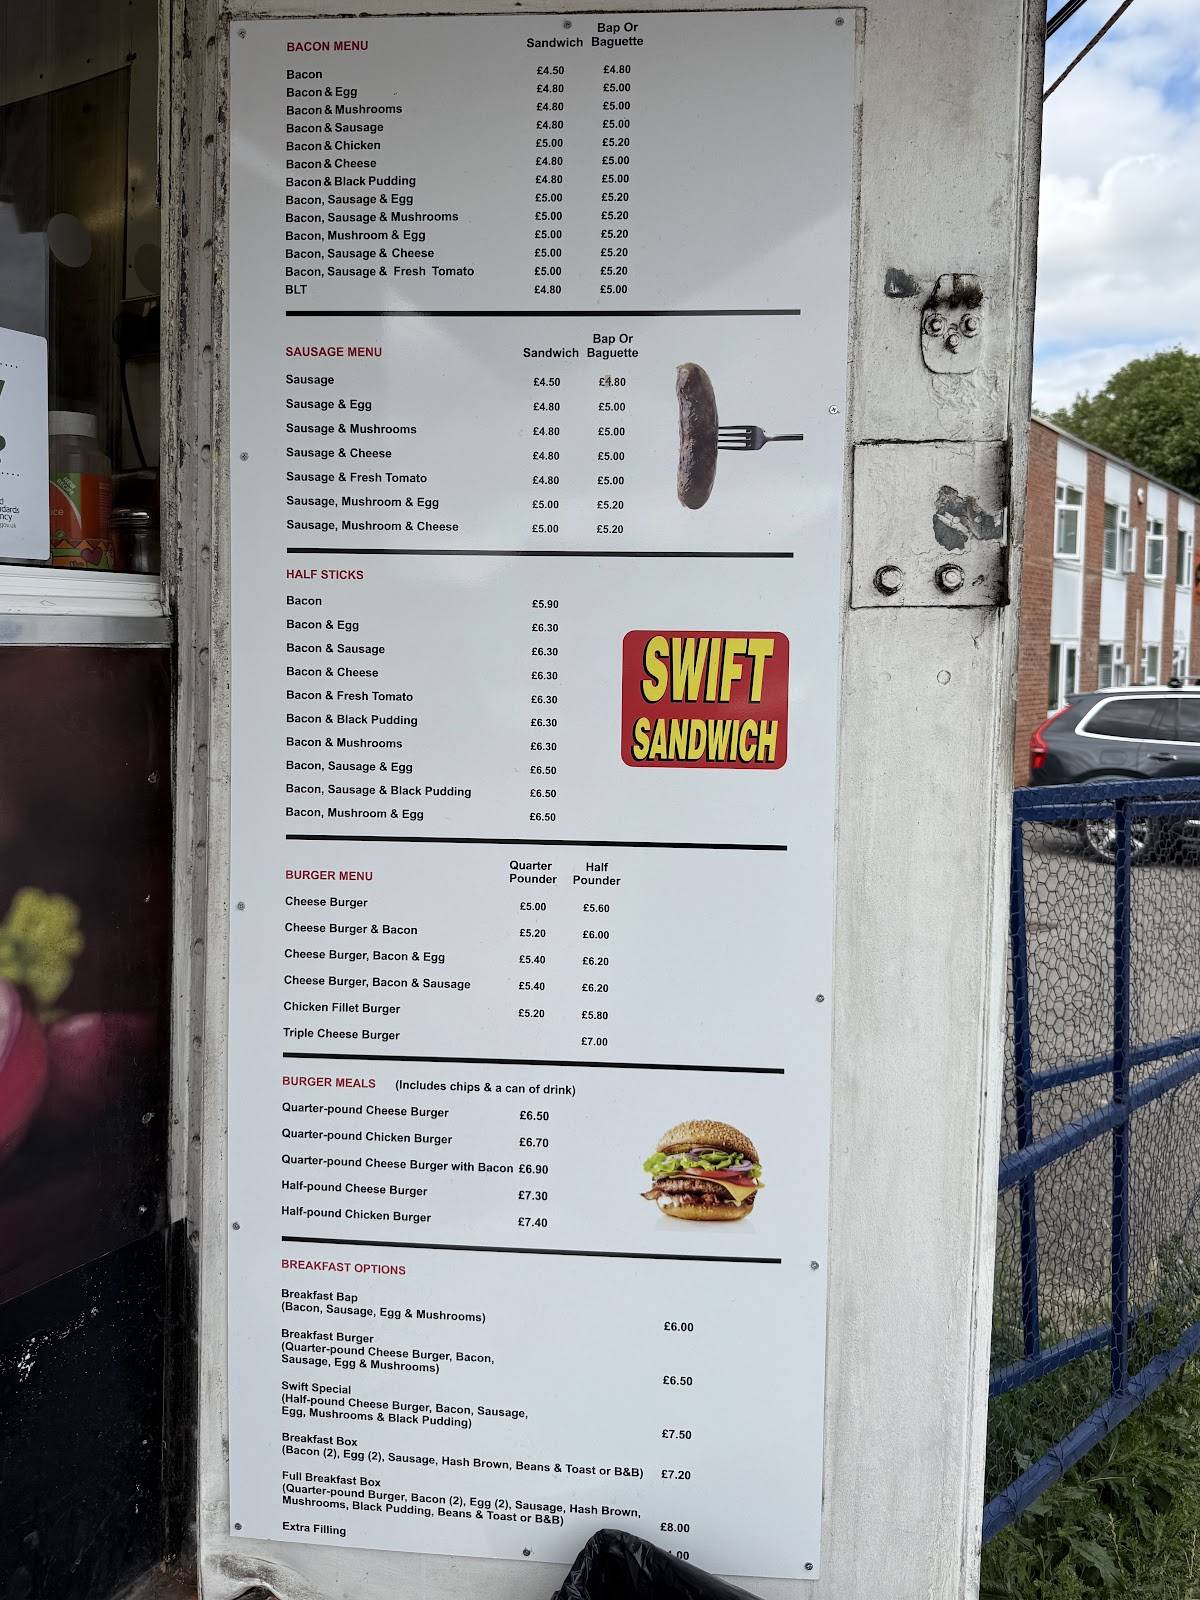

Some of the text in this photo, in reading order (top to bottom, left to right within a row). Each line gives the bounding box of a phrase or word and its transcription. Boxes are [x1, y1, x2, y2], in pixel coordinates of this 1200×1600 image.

[597, 22, 639, 35] Bap Or
[286, 40, 368, 52] BACON MENU
[526, 36, 584, 48] Sandwich
[591, 36, 644, 49] Baguette
[286, 69, 323, 80] Bacon
[536, 65, 565, 75] £4.50
[603, 64, 631, 74] £4.80
[286, 104, 402, 116] Bacon & Mushrooms
[536, 102, 564, 112] £4.80
[602, 101, 631, 111] £5.00
[286, 175, 416, 188] Bacon & Black Pudding
[535, 174, 563, 184] £4.80
[601, 174, 630, 184] £5.00
[285, 248, 435, 261] Bacon, Sausage & Cheese
[534, 248, 562, 258] £5.00
[600, 247, 628, 257] £5.20
[285, 284, 308, 295] BLT
[534, 284, 562, 294] £4.80
[600, 284, 628, 294] £5.00
[593, 333, 634, 346] Bap Or
[285, 346, 382, 357] SAUSAGE MENU
[523, 347, 579, 358] Sandwich
[587, 347, 639, 360] Baguette
[286, 398, 372, 412] Sausage & Egg
[533, 402, 560, 412] £4.80
[598, 402, 626, 412] £5.00
[286, 495, 439, 510] Sausage, Mushroom & Egg
[532, 500, 559, 509] £5.00
[596, 500, 624, 510] £5.20
[286, 569, 364, 580] HALF STICKS
[286, 619, 359, 632] Bacon & Egg
[531, 623, 559, 632] £6.30
[640, 635, 775, 703] SWIFT
[631, 716, 779, 764] SANDWICH
[286, 760, 413, 774] Bacon, Sausage & Egg
[530, 765, 557, 775] £6.50
[286, 807, 424, 822] Bacon, Mushroom & Egg
[529, 812, 556, 822] £6.50
[509, 860, 553, 871] Quarter
[586, 862, 609, 872] Half
[286, 870, 373, 881] BURGER MENU
[509, 873, 558, 884] Pounder
[573, 875, 621, 886] Pounder
[284, 974, 471, 992] Cheese Burger, Bacon & Sausage
[518, 981, 545, 991] £5.40
[581, 983, 609, 993] £6.20
[282, 1027, 400, 1042] Triple Cheese Burger
[581, 1036, 608, 1046] £7.00
[282, 1076, 376, 1088] BURGER MEALS
[395, 1079, 576, 1098] (Includes chips & a can of drink)
[282, 1102, 449, 1120] Quarter-pound Cheese Burger
[519, 1110, 550, 1121] £6.50
[281, 1154, 514, 1173] Quarter-pound Cheese Burger with Bacon
[518, 1164, 549, 1175] £6.90
[281, 1206, 432, 1224] Half-pound Chicken Burger
[518, 1216, 548, 1228] £7.40
[281, 1259, 406, 1275] BREAKFAST OPTIONS
[281, 1288, 358, 1304] Breakfast Bap
[281, 1301, 486, 1324] (Bacon, Sausage, Egg & Mushrooms)
[664, 1321, 694, 1332] £6.00
[281, 1328, 374, 1345] Breakfast Burger
[662, 1375, 693, 1386] £6.50
[281, 1380, 351, 1395] Swift Special
[281, 1406, 472, 1430] Egg, Mushrooms & Black Pudding)
[282, 1432, 358, 1447] Breakfast Box
[661, 1428, 692, 1440] £7.50
[282, 1444, 644, 1480] (Bacon (2), Egg (2), Sausage, Hash Brown, Beans & Toast or B&B)
[282, 1470, 381, 1487] Full Breakfast Box
[661, 1469, 691, 1480] £7.20
[282, 1521, 346, 1538] Extra Filling
[660, 1522, 690, 1533] £8.00
